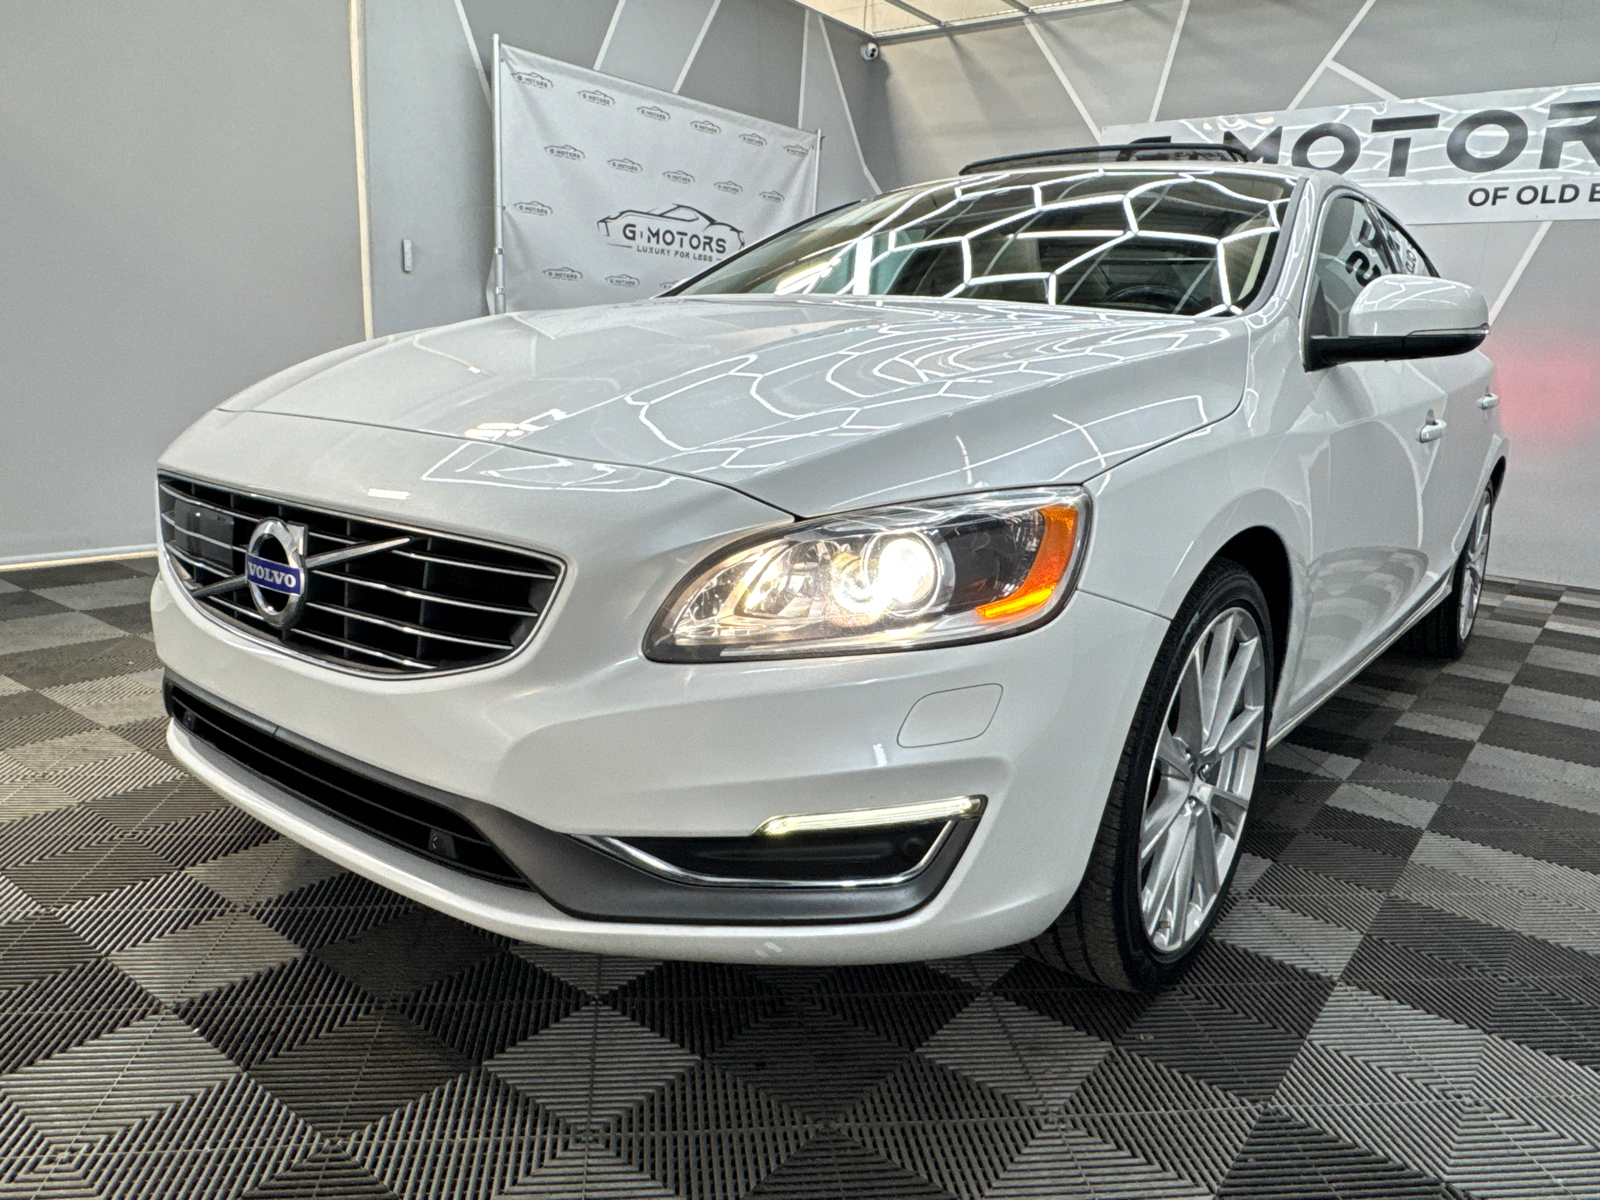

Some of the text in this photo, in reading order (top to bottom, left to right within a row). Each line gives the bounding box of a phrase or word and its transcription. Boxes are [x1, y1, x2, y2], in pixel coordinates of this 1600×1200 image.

[1468, 186, 1509, 206] OF
[1516, 183, 1580, 205] OLD
[622, 223, 727, 254] G MOTORS
[636, 245, 713, 262] LUXURY FOR LESS
[247, 561, 297, 588] VOLVO
